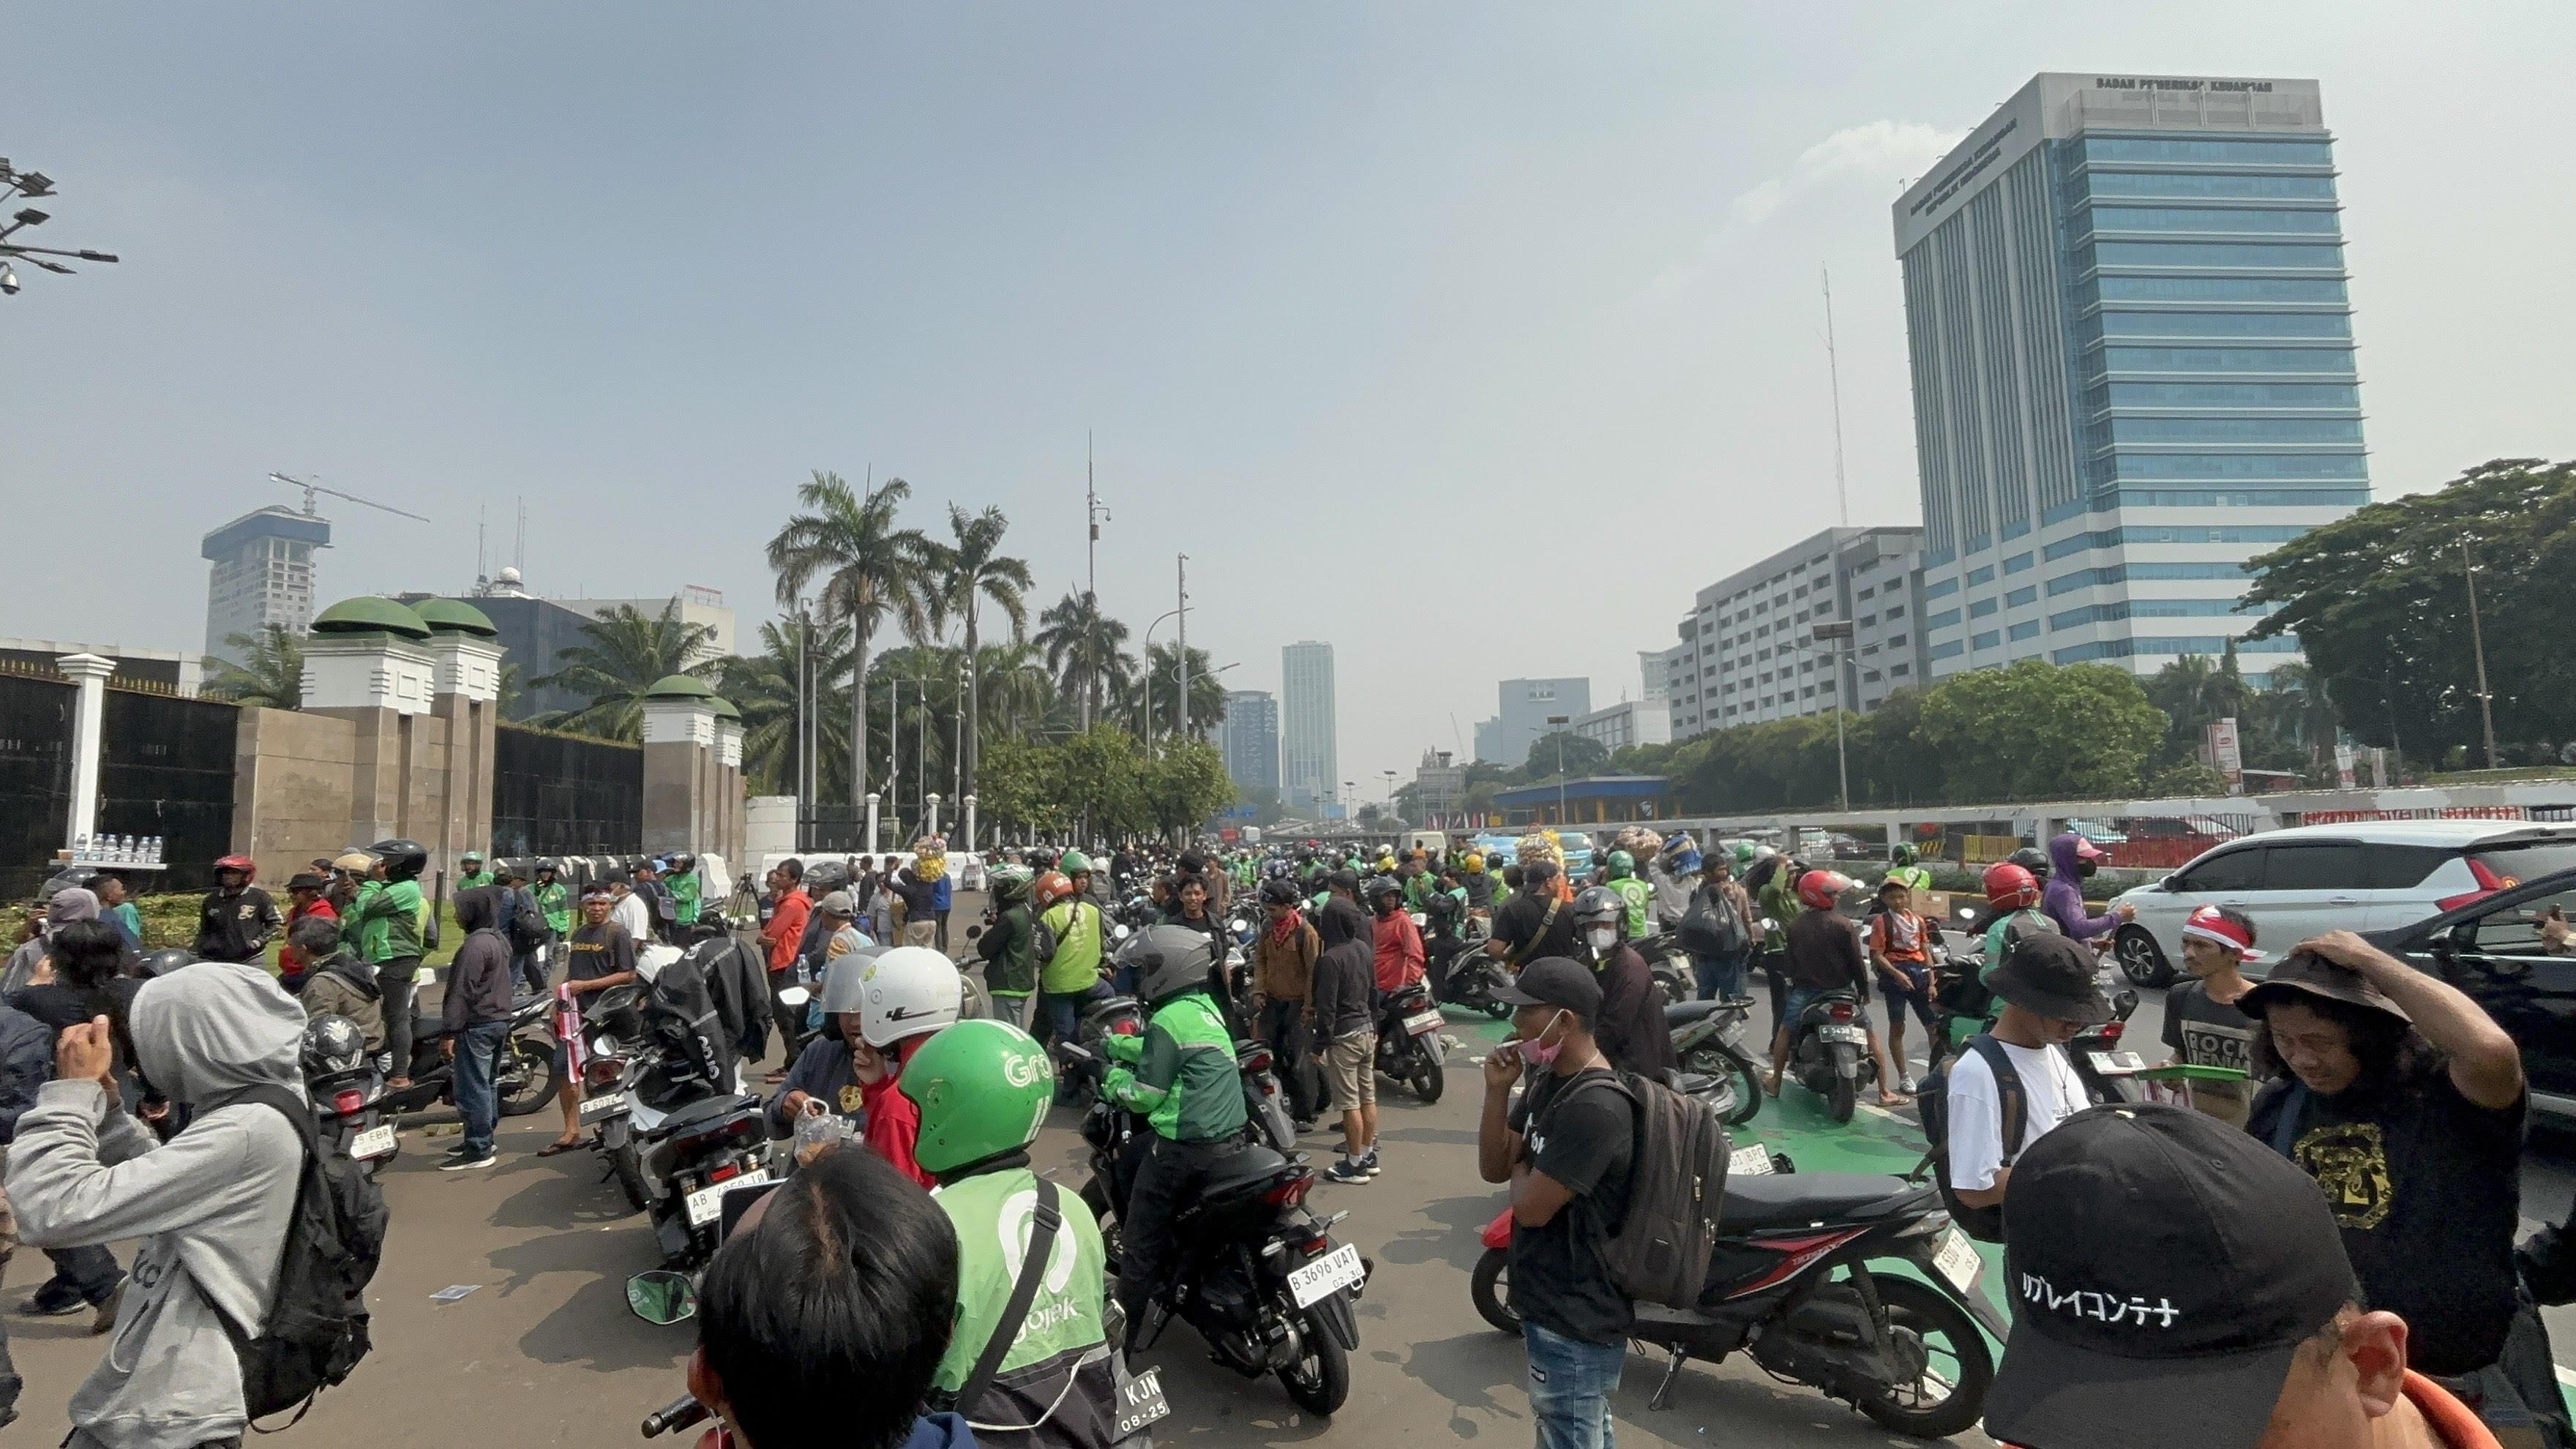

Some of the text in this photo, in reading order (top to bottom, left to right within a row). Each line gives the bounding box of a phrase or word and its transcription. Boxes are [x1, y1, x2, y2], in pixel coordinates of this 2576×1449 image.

[369, 1128, 389, 1141] EBR
[1745, 1147, 1765, 1161] BPC
[692, 1194, 708, 1208] AB
[1291, 1248, 1355, 1290] B 3696 VAT
[1125, 1374, 1161, 1405] KJN
